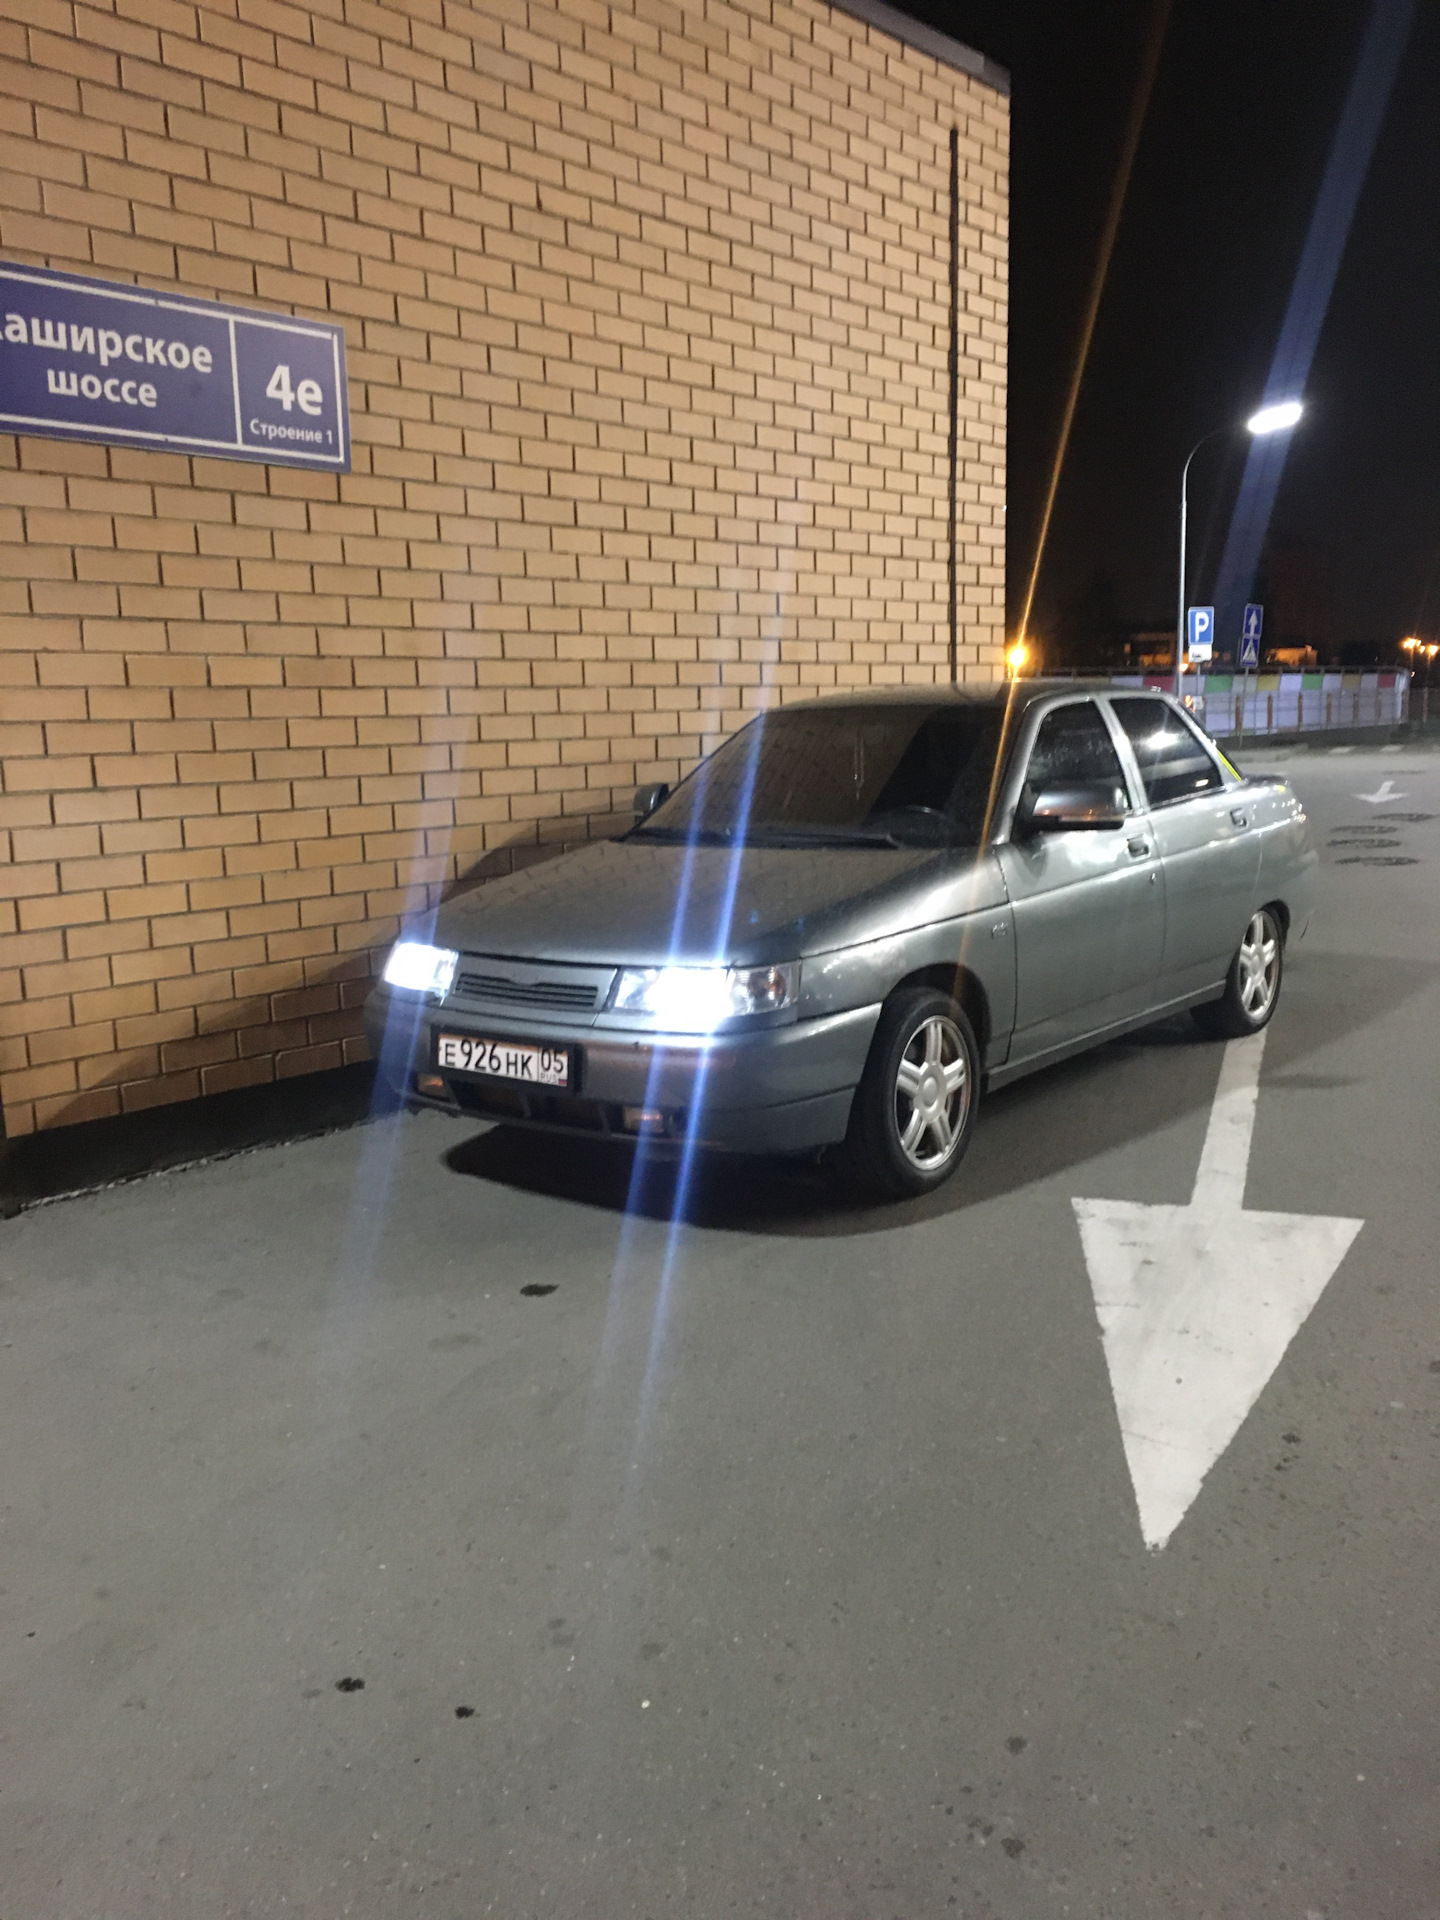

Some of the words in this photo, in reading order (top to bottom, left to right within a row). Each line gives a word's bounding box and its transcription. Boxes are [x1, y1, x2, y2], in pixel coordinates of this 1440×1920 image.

[0, 313, 213, 373] аширское
[47, 368, 157, 408] шоссе
[249, 418, 323, 443] Строение
[326, 429, 333, 445] 1
[1194, 611, 1209, 641] P
[541, 1048, 564, 1074] 05
